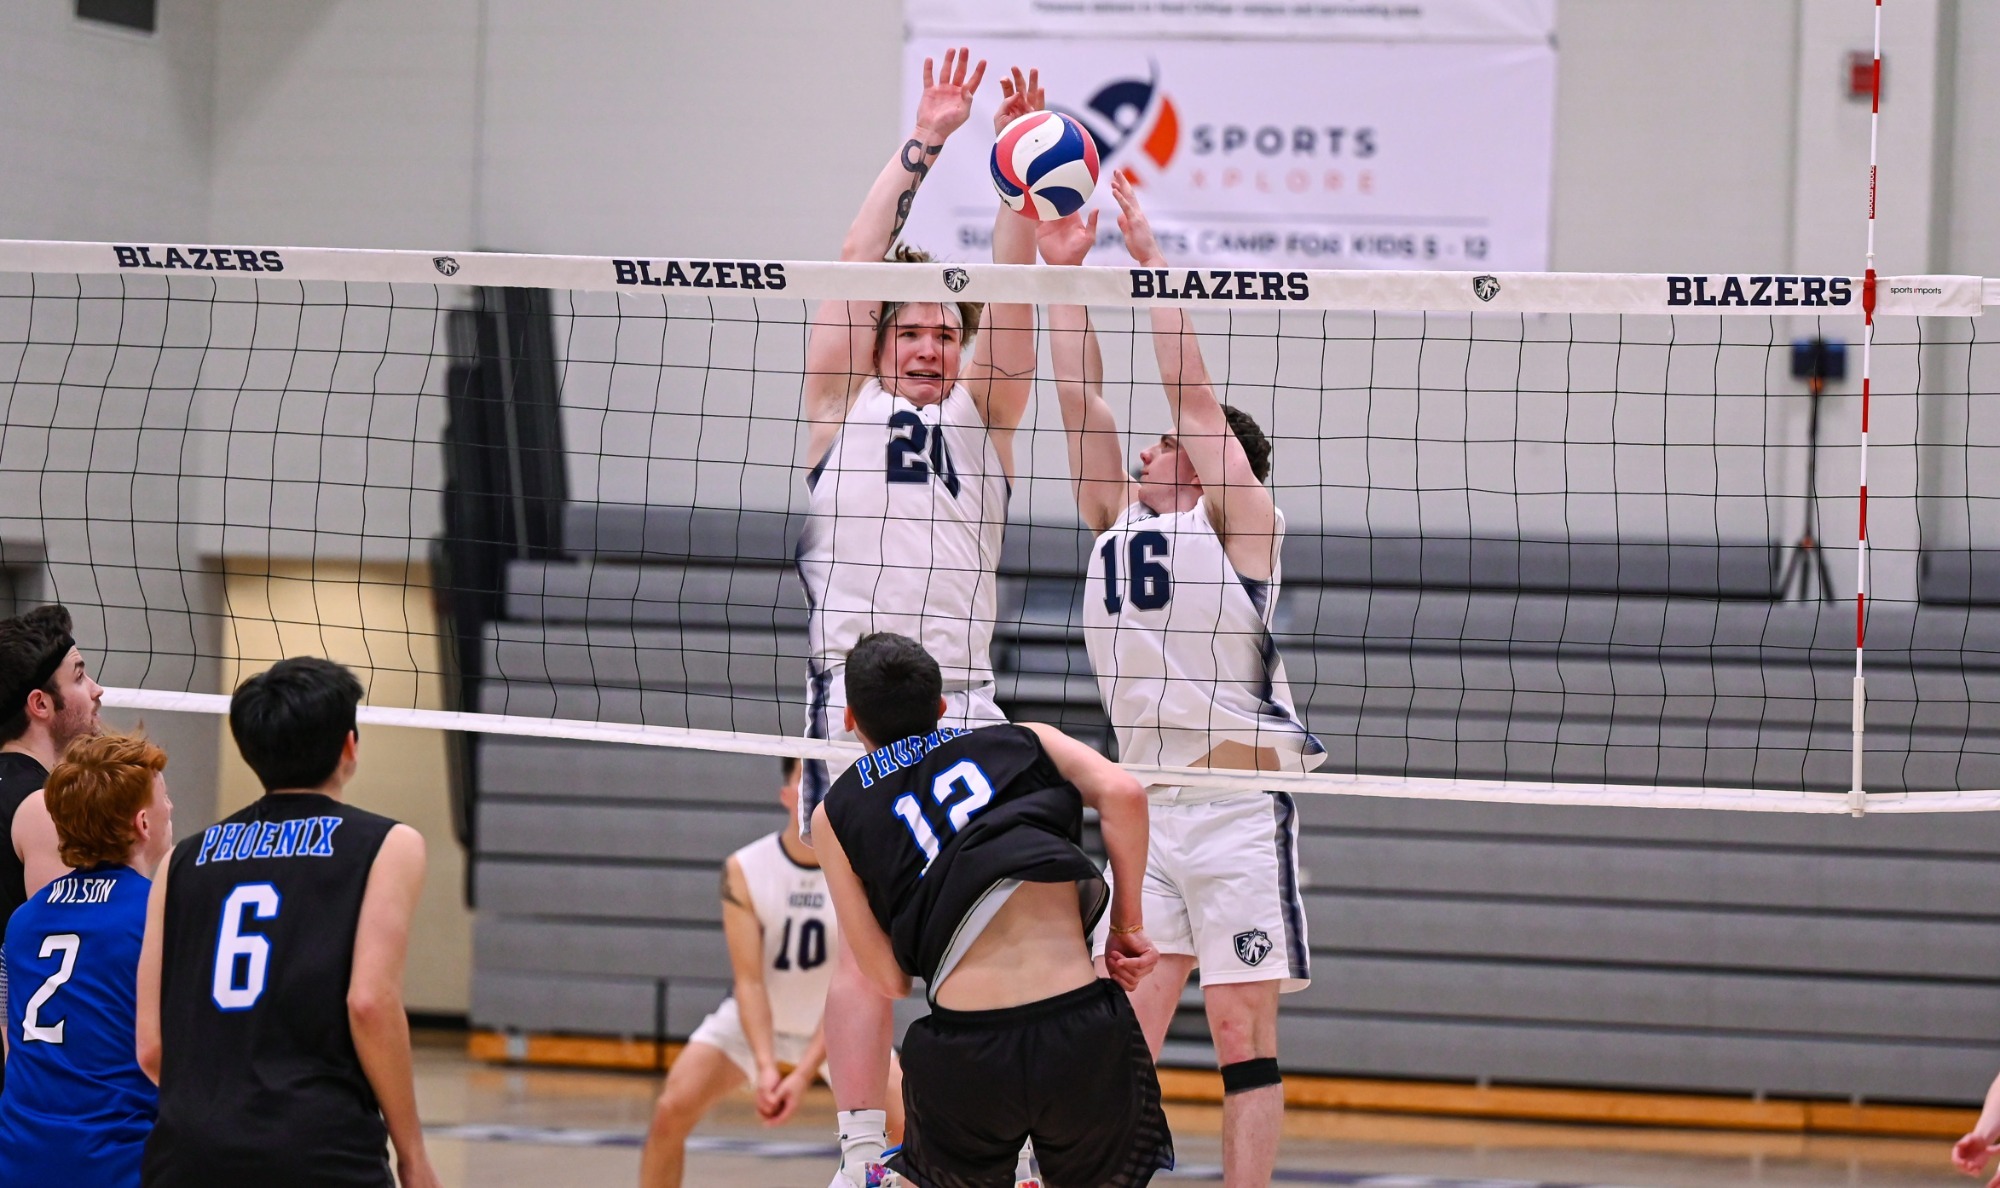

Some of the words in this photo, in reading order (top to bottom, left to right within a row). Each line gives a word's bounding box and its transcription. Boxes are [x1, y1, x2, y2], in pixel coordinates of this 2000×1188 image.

[1192, 126, 1378, 158] SPORTS
[1189, 167, 1376, 195] XPLORE
[113, 246, 284, 272] BLAZERS
[1093, 230, 1188, 254] SPTS
[1199, 230, 1279, 254] CAMP
[1286, 232, 1342, 256] FOR
[1353, 233, 1416, 258] KIDS
[614, 259, 786, 290] BLAZERS
[1130, 269, 1309, 301] BLAZERS
[1890, 286, 1912, 295] sports
[1914, 287, 1942, 295] imports
[1667, 276, 1851, 306] BLAZERS
[1100, 530, 1172, 616] 16
[891, 757, 995, 879] 12
[196, 816, 343, 866] PHOENIX
[47, 878, 117, 904] WILSON
[211, 881, 281, 1013] 6
[774, 916, 827, 971] 10
[22, 933, 80, 1044] 2
